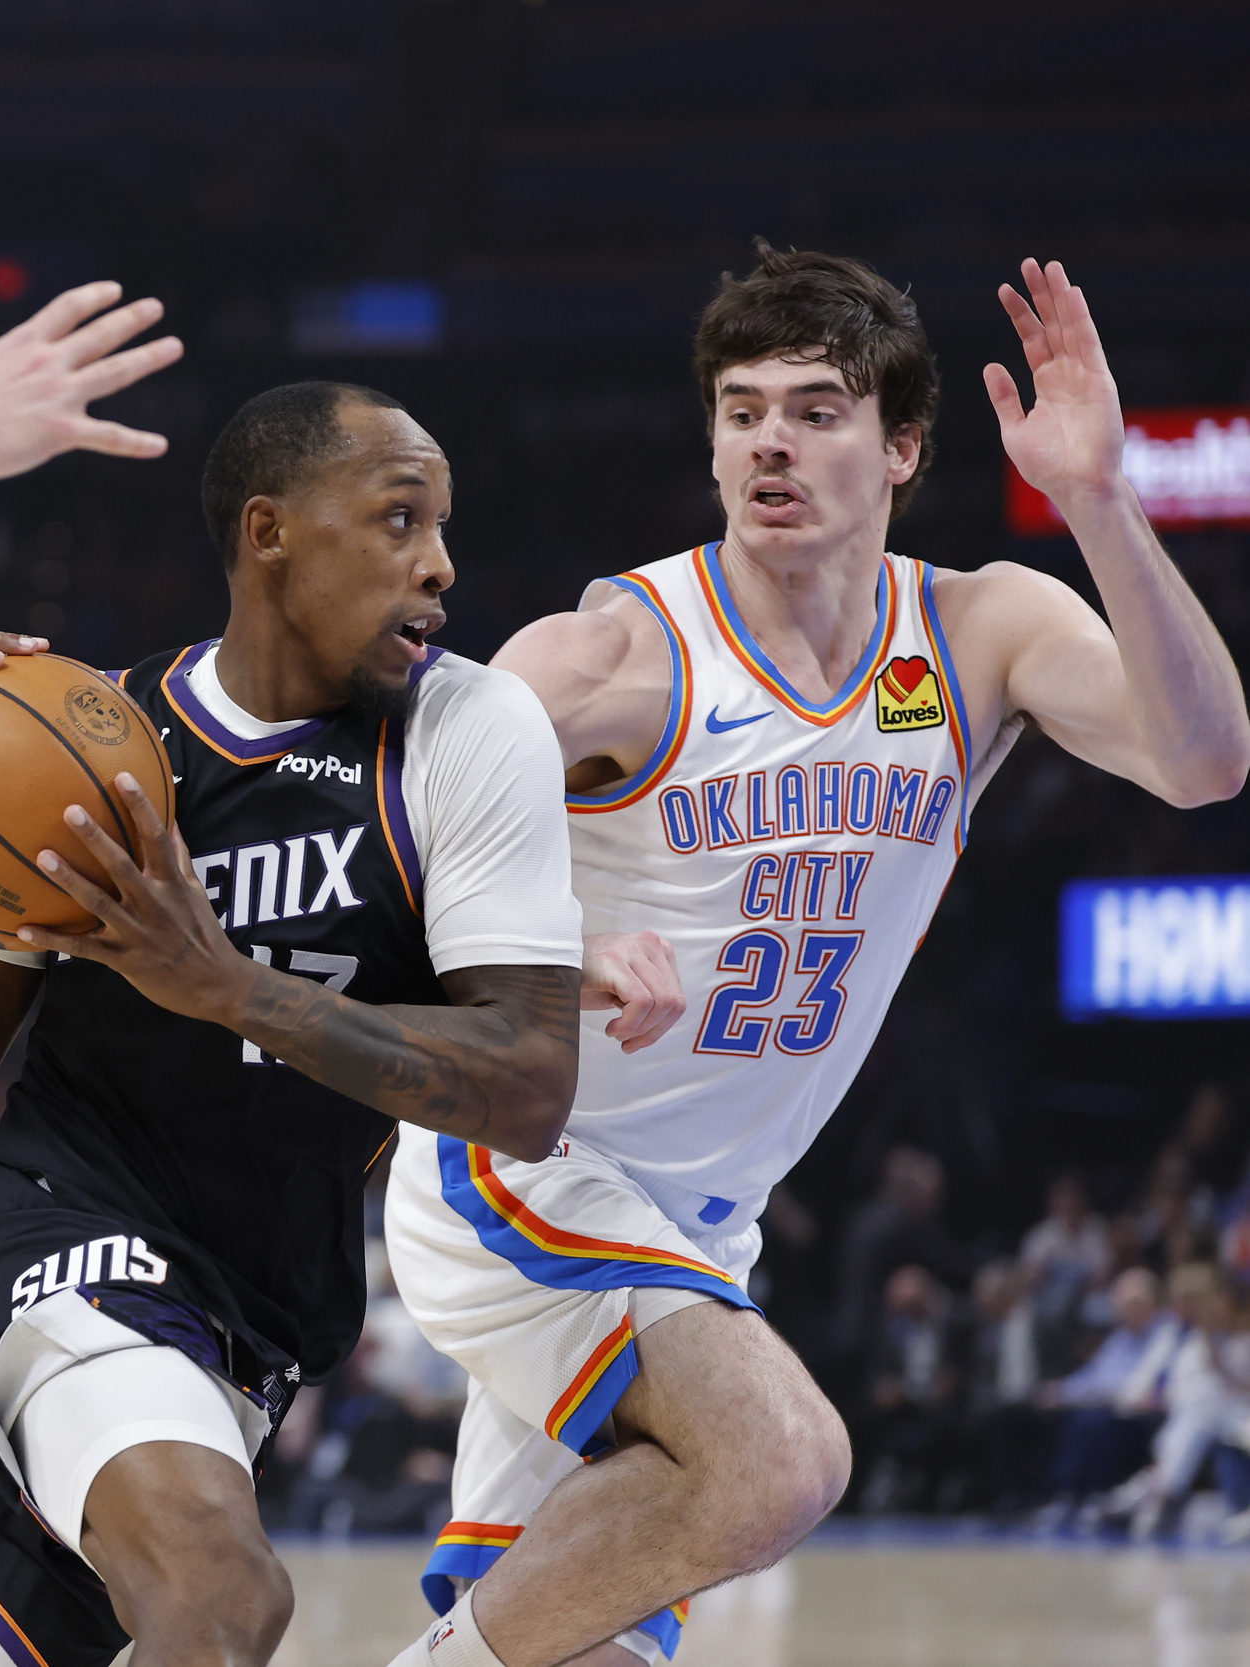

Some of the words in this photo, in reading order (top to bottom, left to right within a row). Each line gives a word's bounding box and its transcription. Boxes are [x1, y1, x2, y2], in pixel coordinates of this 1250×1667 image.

[276, 753, 362, 785] PayPal
[658, 761, 956, 854] OKLAHOMA
[740, 851, 874, 921] CITY
[693, 928, 865, 1058] 23
[12, 1234, 171, 1322] SUNS
